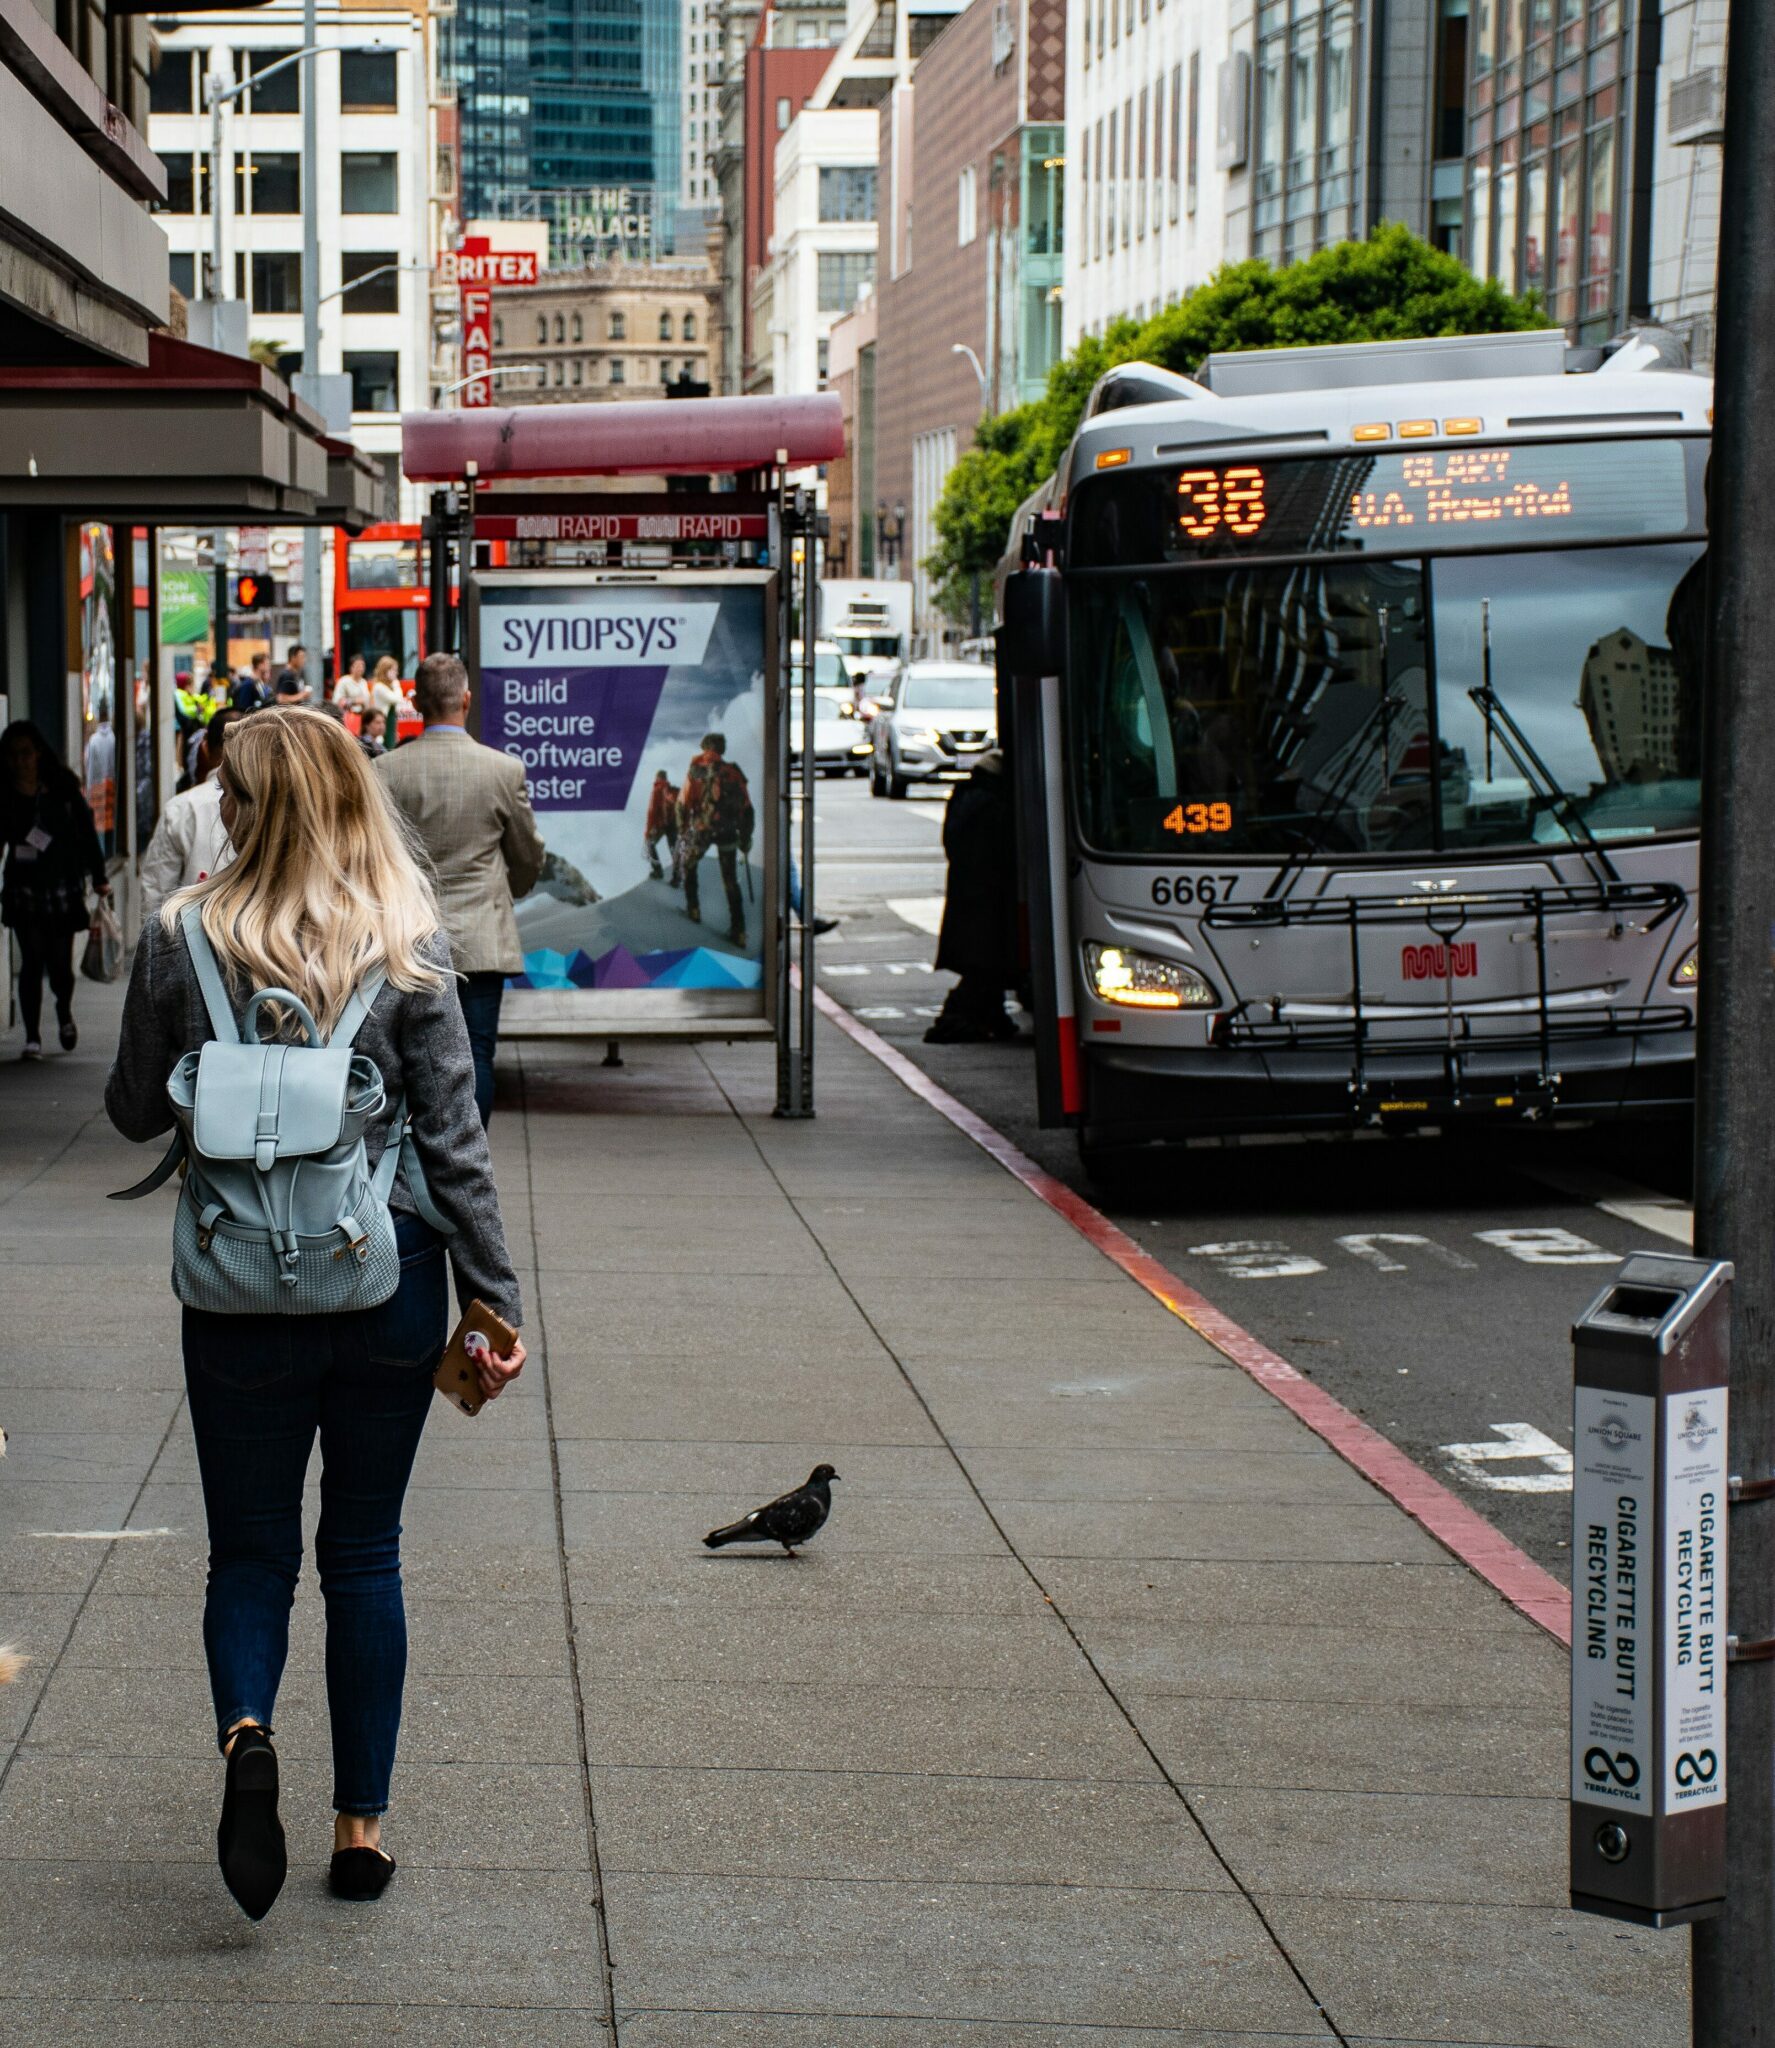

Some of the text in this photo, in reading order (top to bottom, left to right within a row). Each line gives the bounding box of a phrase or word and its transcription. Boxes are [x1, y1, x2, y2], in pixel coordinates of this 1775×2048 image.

[591, 187, 630, 210] THE
[567, 216, 652, 239] PALACE
[440, 253, 534, 281] BRITEX
[466, 292, 490, 405] FABR
[1178, 467, 1266, 536] 38
[561, 515, 621, 538] RAPID
[682, 515, 742, 538] RAPID
[503, 678, 568, 705] Build
[503, 711, 595, 736] Secure
[525, 778, 586, 800] aster
[1163, 802, 1232, 834] 439
[1151, 874, 1240, 905] 6667
[1588, 1426, 1642, 1441] UNION SQUARE
[1677, 1427, 1718, 1440] UNION SQUARE
[1588, 1524, 1608, 1660] RECYCLING
[1616, 1496, 1637, 1700] CIGARETTE BUTT
[1677, 1529, 1693, 1666] RECYCLING
[1699, 1492, 1715, 1694] CIGARETTE BUTT
[1584, 1782, 1641, 1801] TERRACYCLE
[1675, 1784, 1718, 1800] TERRACYCLE
